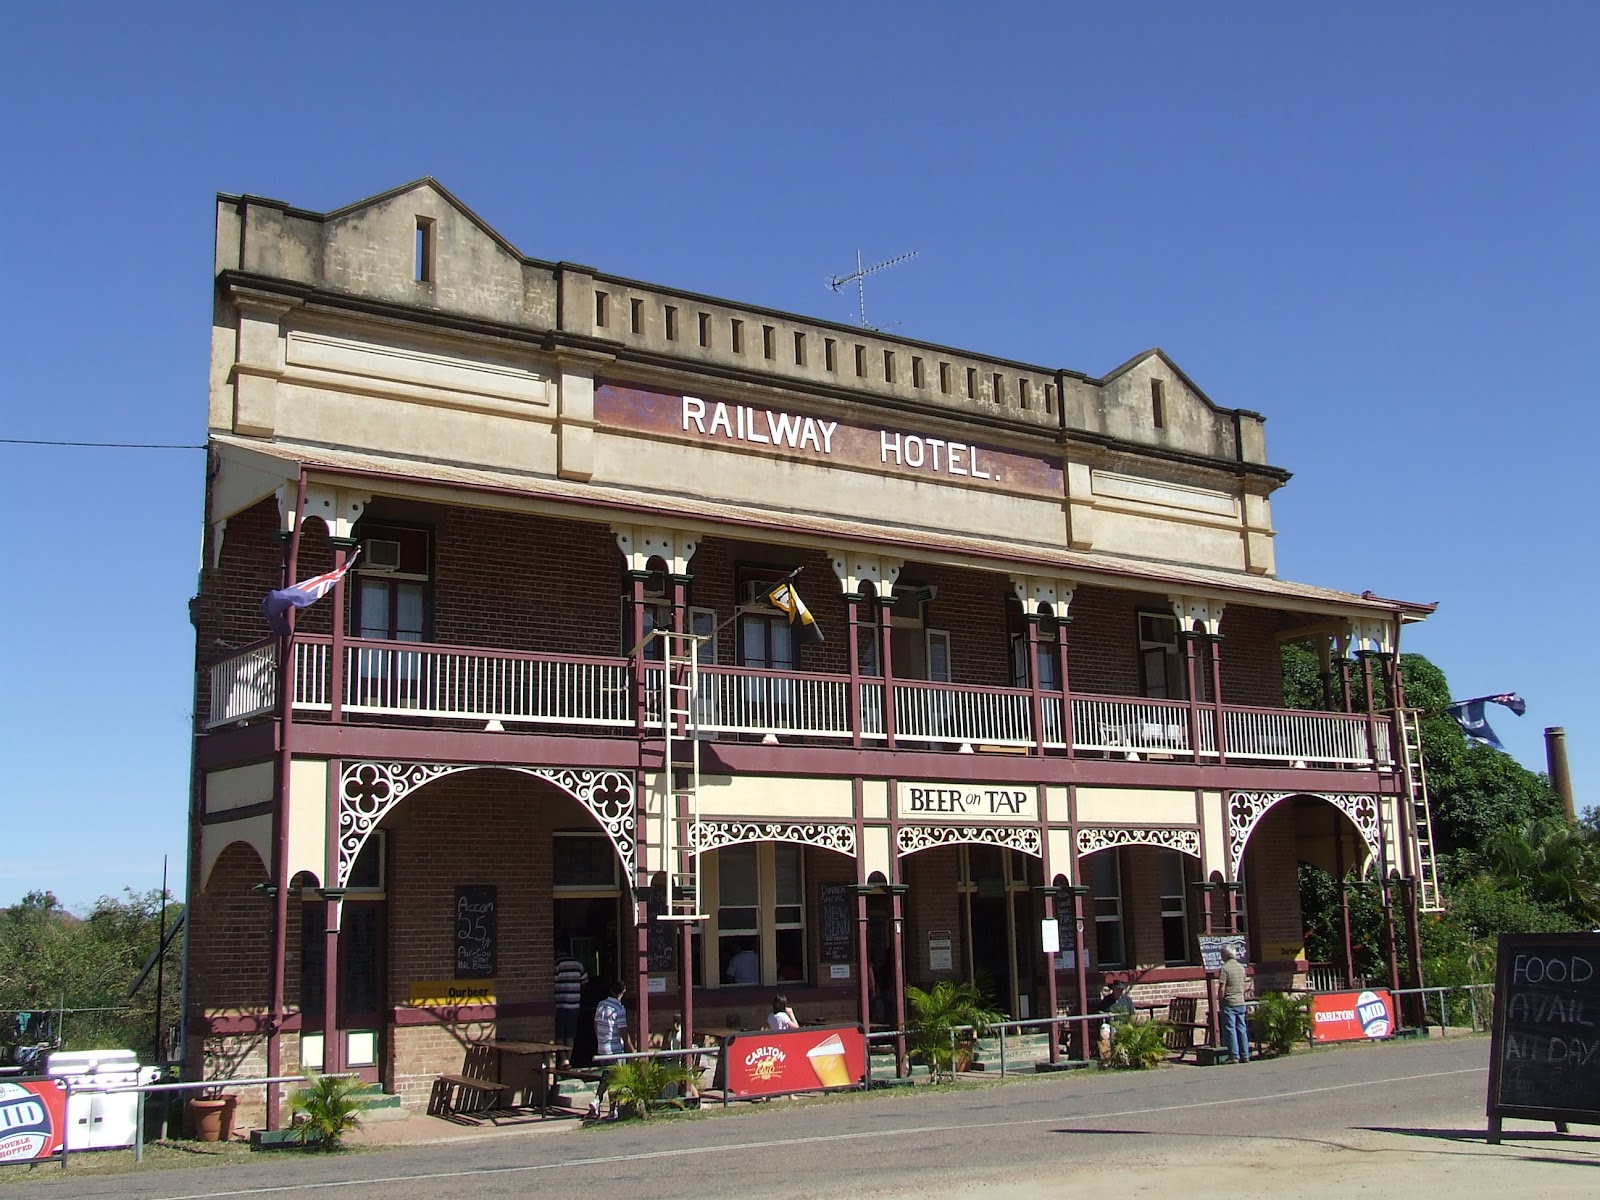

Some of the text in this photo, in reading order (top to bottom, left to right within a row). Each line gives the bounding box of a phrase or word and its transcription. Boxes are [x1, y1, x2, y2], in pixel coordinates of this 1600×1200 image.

[681, 396, 1001, 481] RAILWAY HOTEL.
[910, 788, 1027, 814] BEER on TAP
[823, 905, 849, 920] NEW
[824, 920, 850, 937] MENU
[1513, 954, 1593, 984] FOOD
[448, 987, 489, 998] Our beer
[1314, 1009, 1355, 1023] CARLTON
[1358, 1002, 1386, 1025] MID
[1508, 992, 1595, 1027] AVAIL
[745, 1046, 787, 1066] CARLTON
[1547, 1036, 1600, 1066] DAY
[0, 1101, 45, 1131] ID
